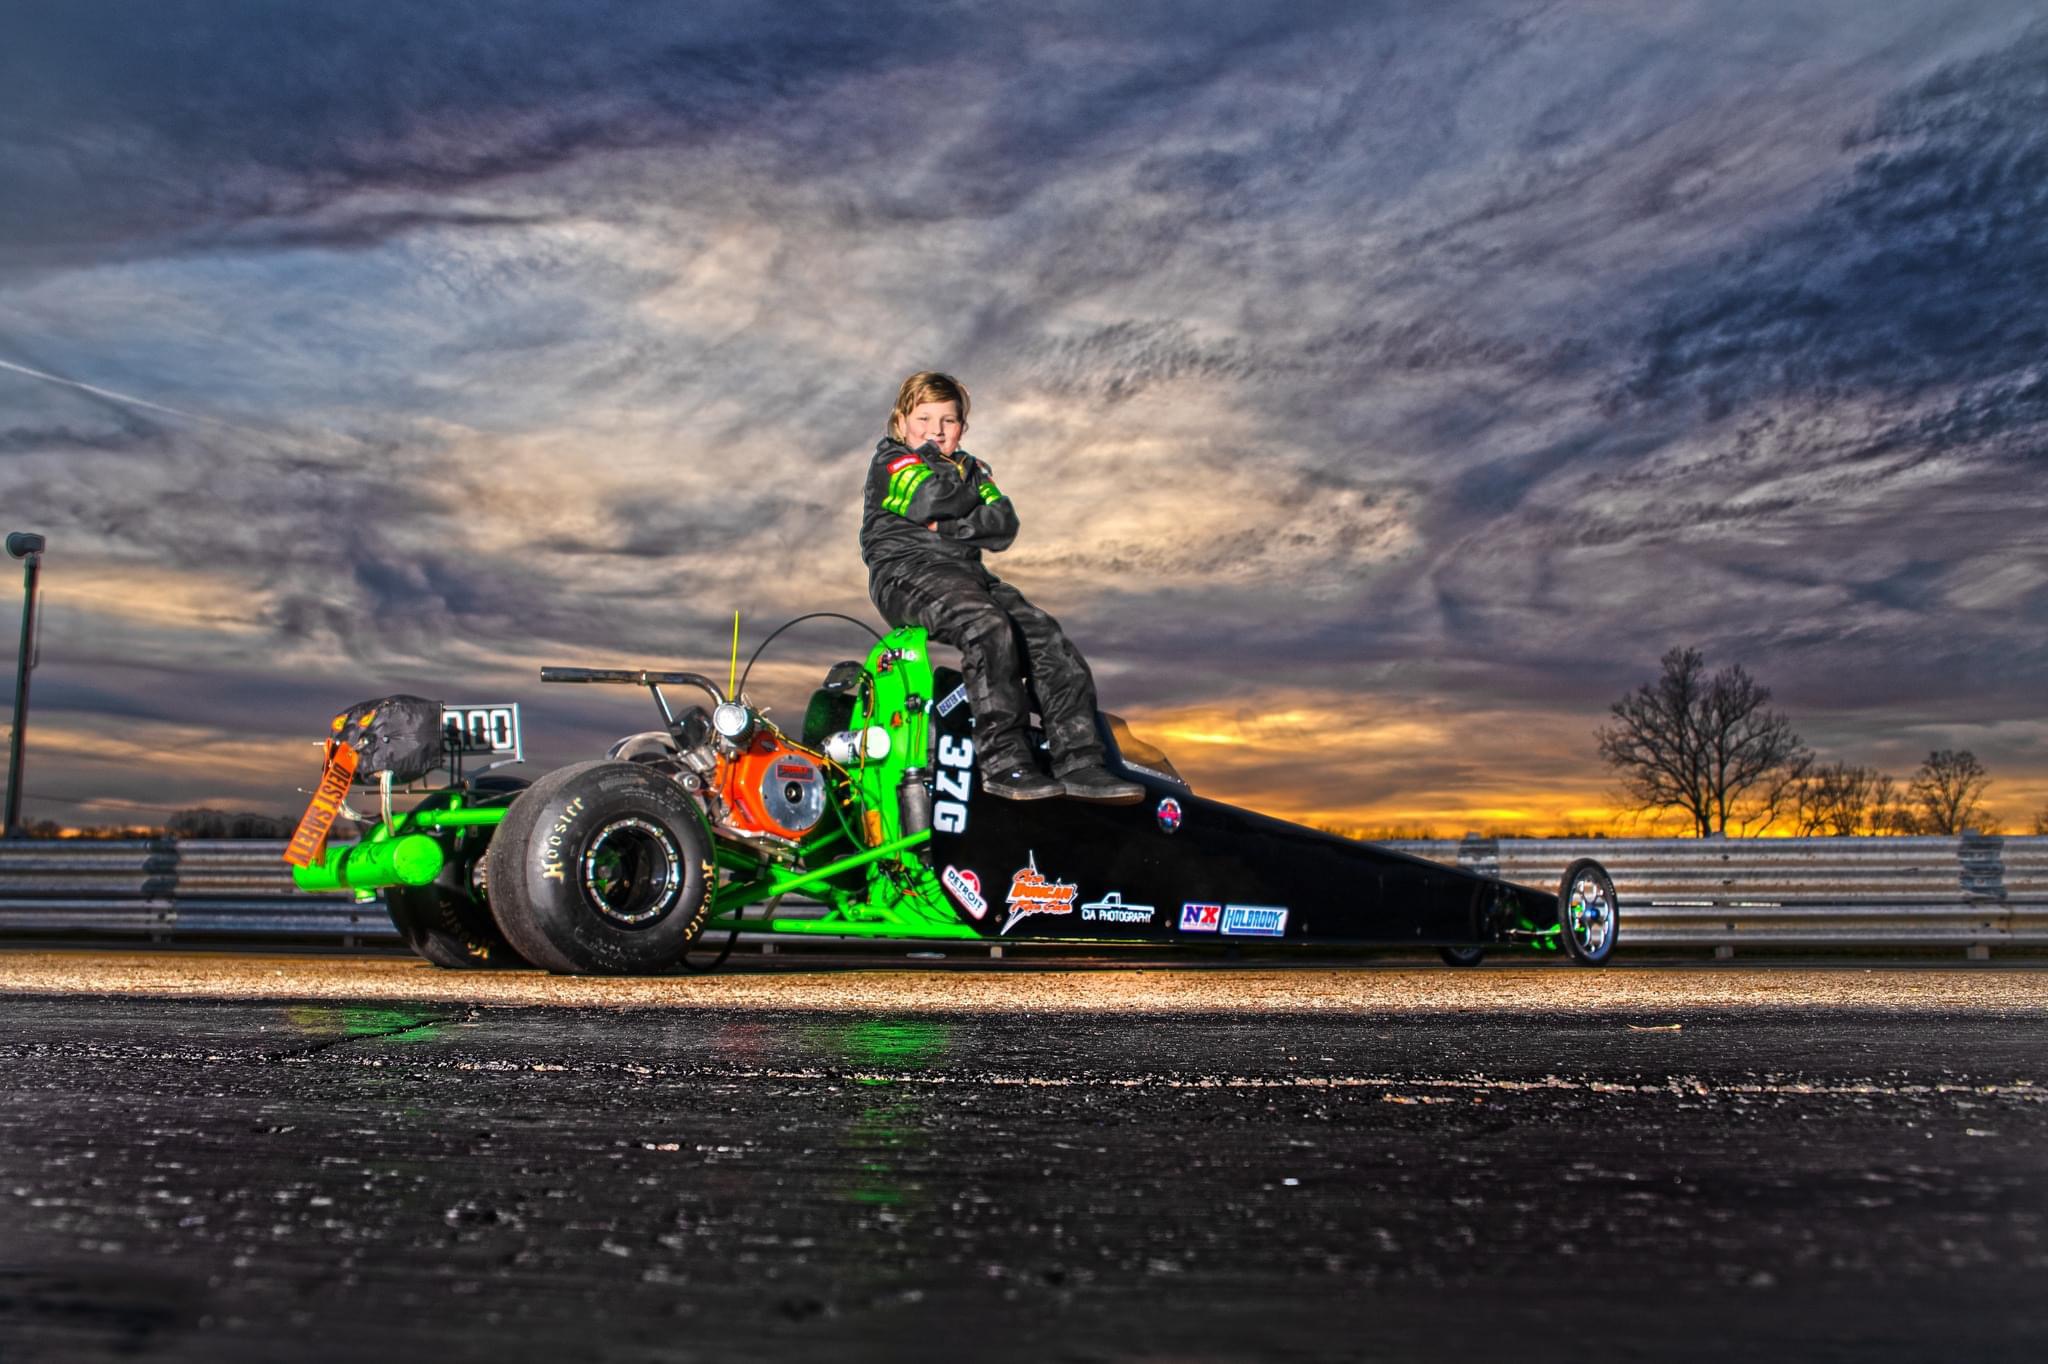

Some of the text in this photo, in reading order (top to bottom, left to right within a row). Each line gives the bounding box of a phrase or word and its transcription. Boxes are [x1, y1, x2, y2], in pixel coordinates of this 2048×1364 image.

[292, 762, 351, 864] DEIST SAFETY
[542, 797, 584, 884] Hoosier
[683, 858, 716, 941] Hoosier
[948, 870, 983, 909] DETROIT
[1099, 910, 1151, 923] PHOTOGRAPHY
[1184, 906, 1219, 923] NX
[1225, 909, 1284, 930] HOLBROOK
